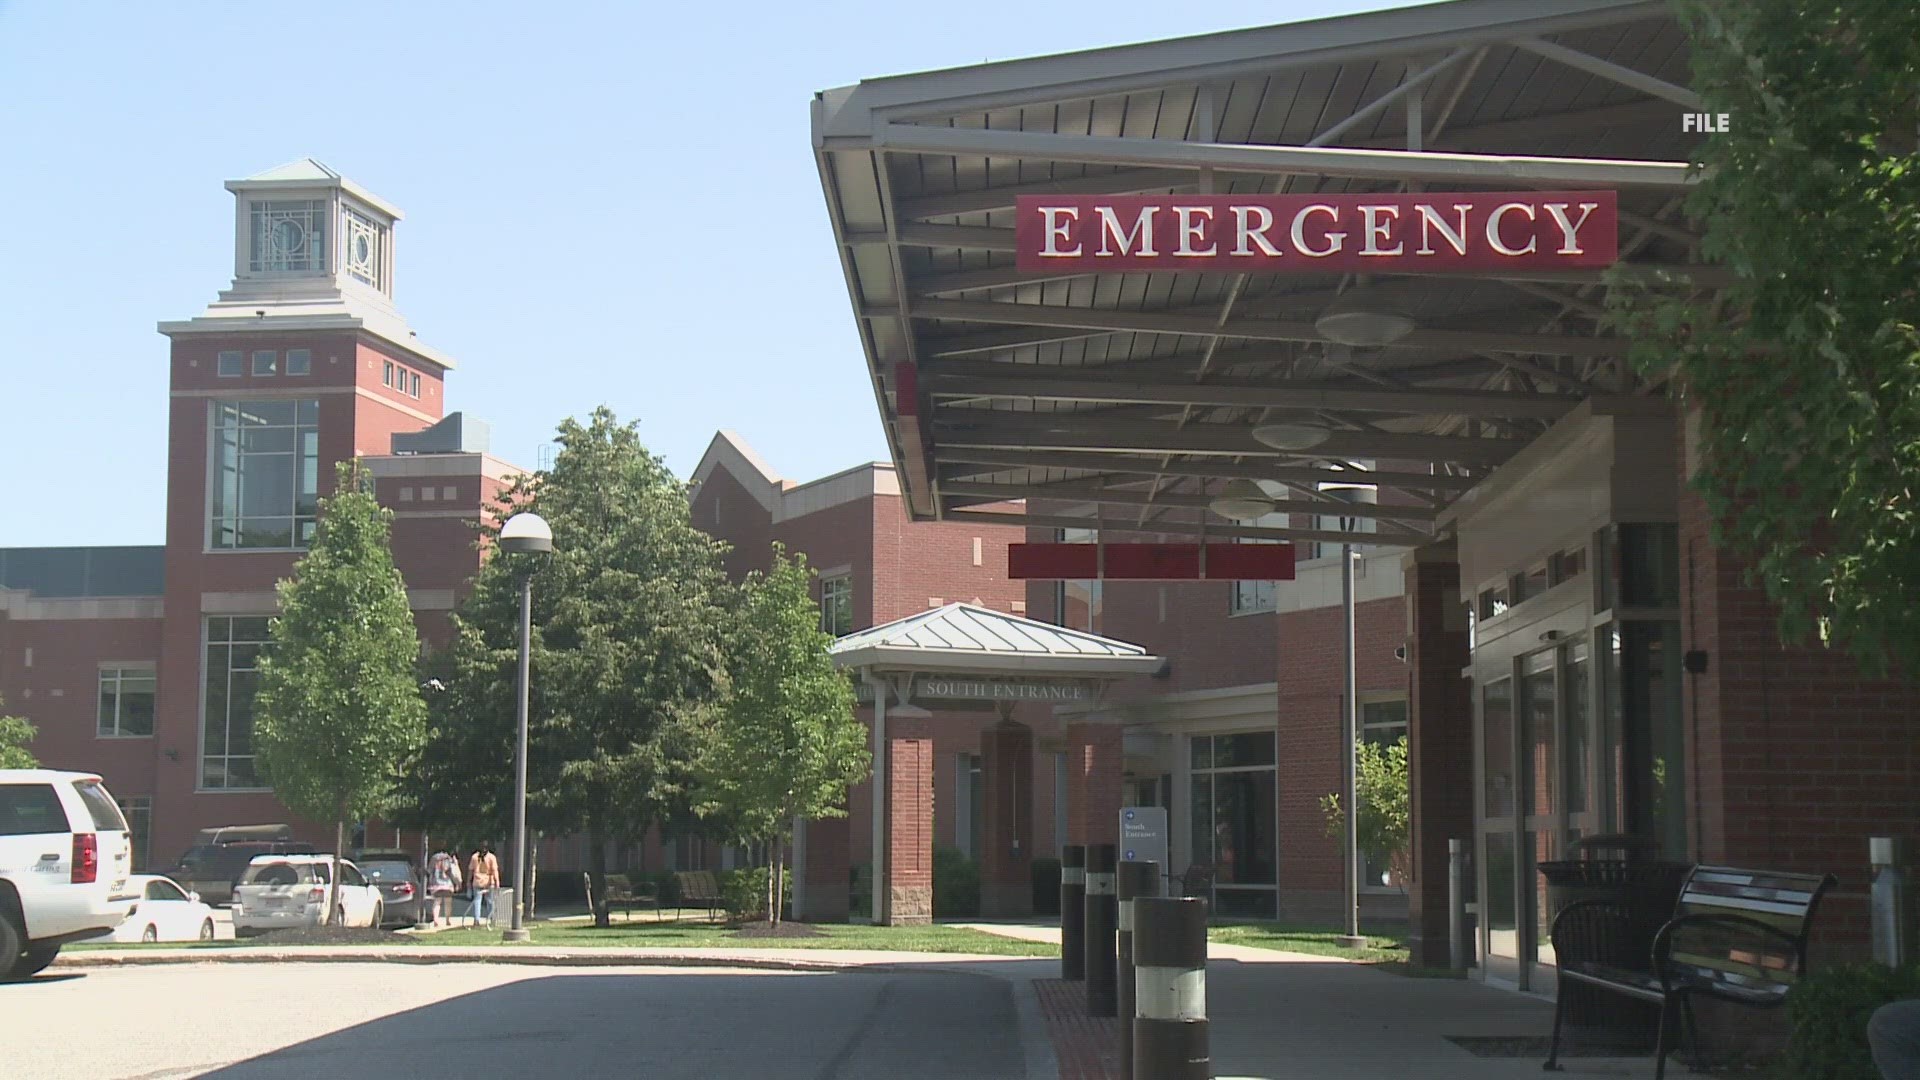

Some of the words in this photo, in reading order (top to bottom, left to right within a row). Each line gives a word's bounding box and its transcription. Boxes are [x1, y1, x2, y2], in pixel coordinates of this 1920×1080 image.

[1037, 202, 1600, 258] EMERGENCY
[926, 682, 986, 697] SOUTH
[993, 684, 1083, 700] ENTRANCE
